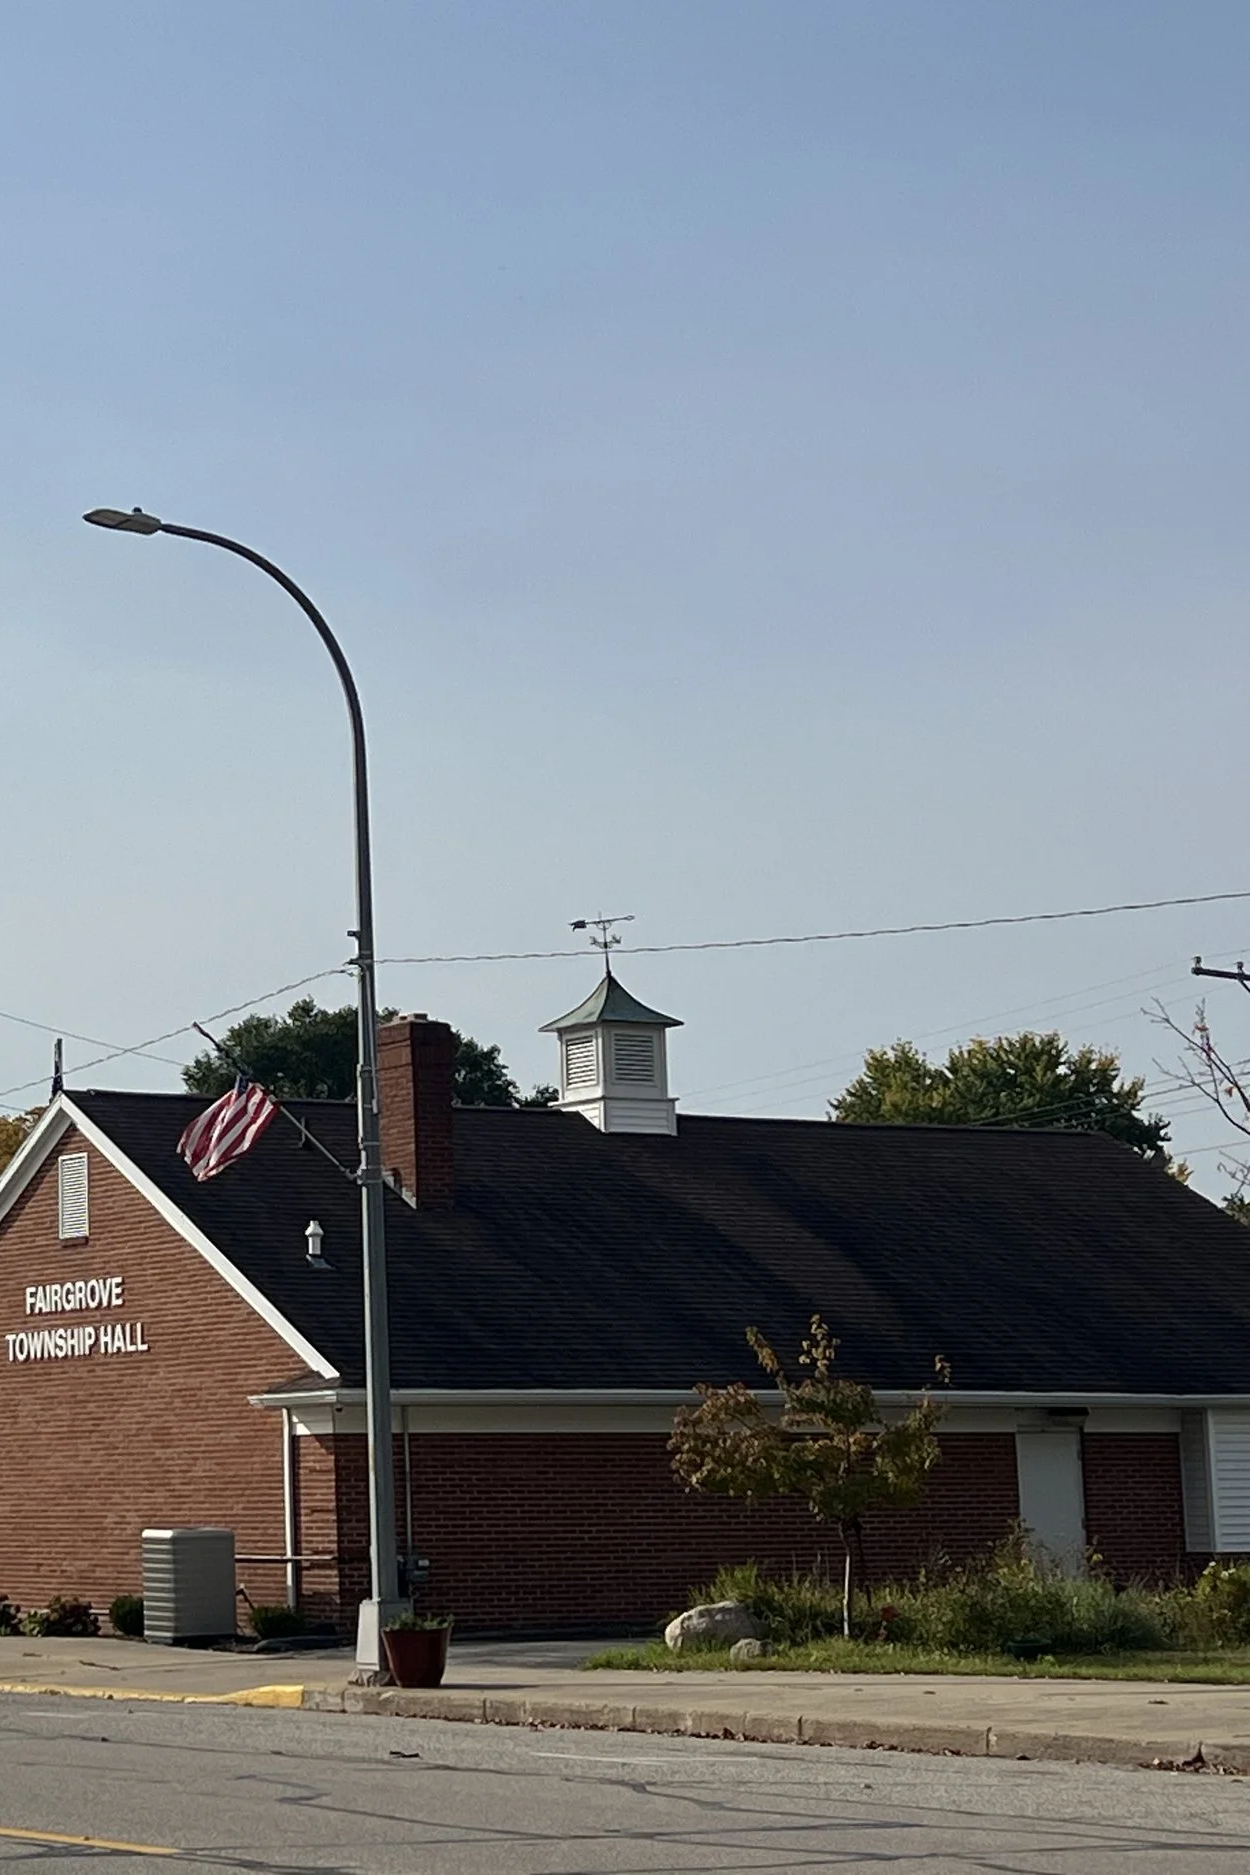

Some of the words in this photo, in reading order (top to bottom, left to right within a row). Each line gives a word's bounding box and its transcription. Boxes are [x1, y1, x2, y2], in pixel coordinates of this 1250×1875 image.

[25, 1276, 124, 1315] FAIRGROVE
[5, 1326, 96, 1362] TOWNSHIP
[100, 1322, 149, 1354] HALL
